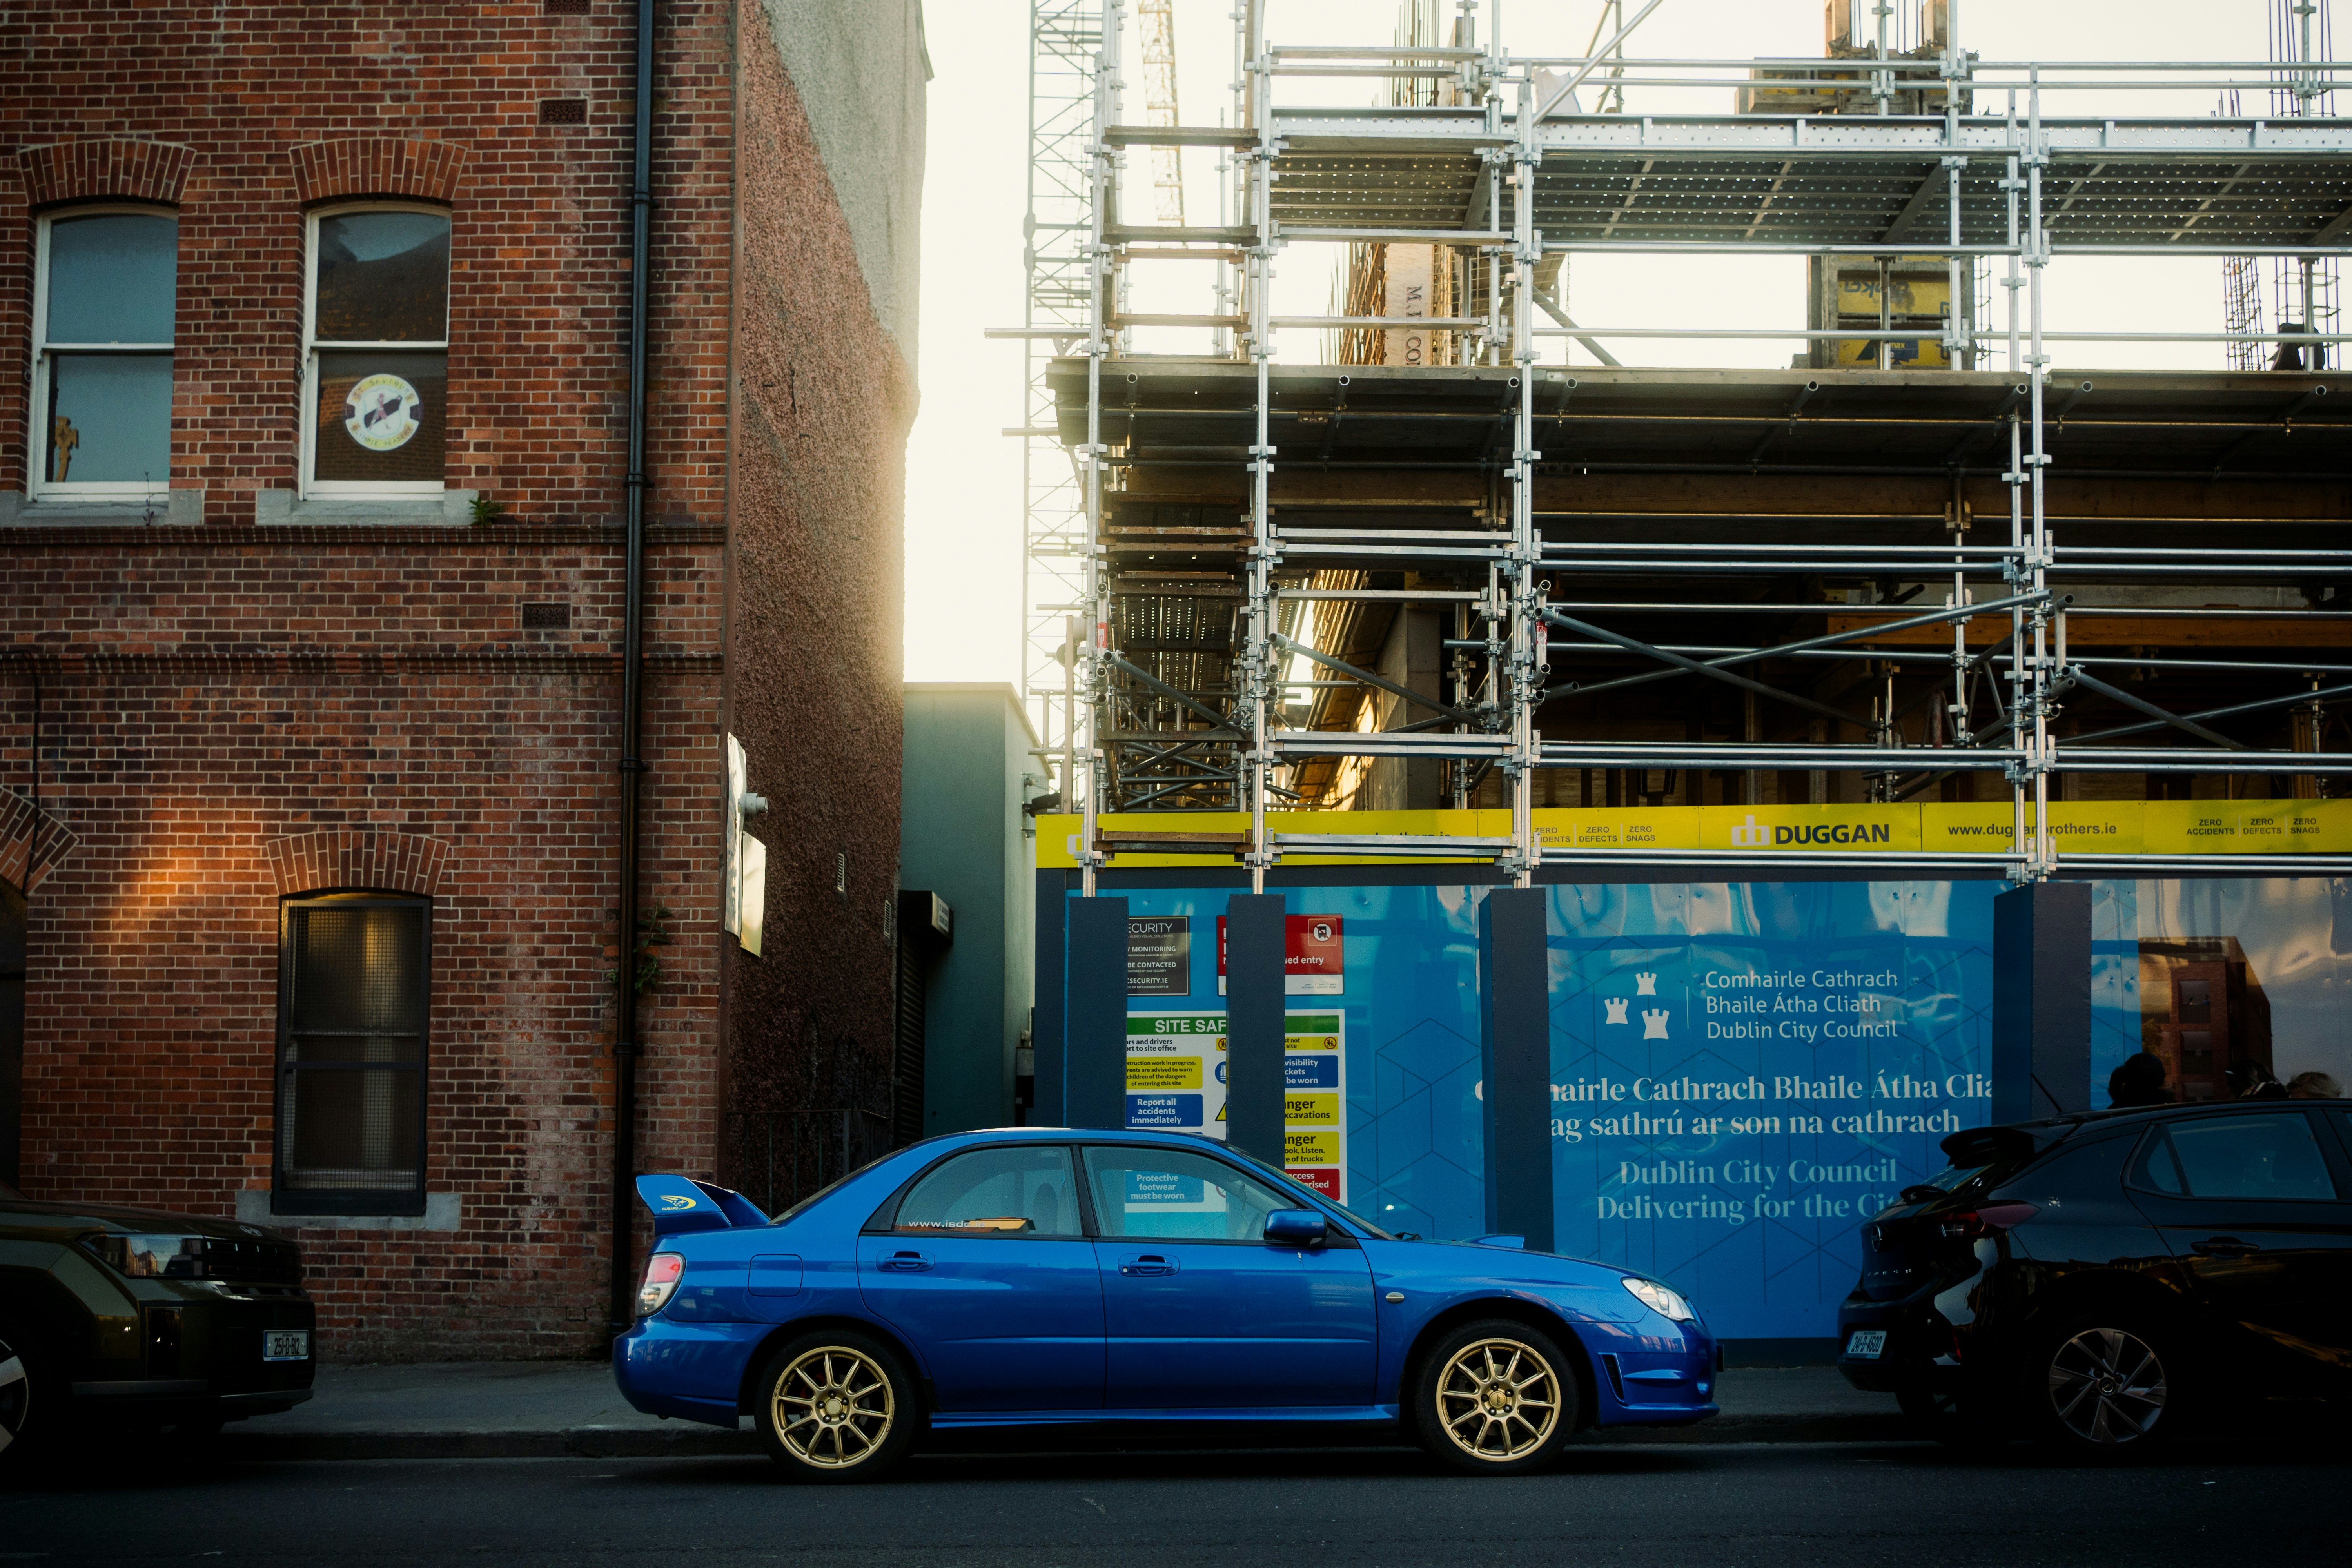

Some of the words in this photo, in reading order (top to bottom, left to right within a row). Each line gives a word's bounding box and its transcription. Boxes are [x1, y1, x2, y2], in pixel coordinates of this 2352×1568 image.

[1775, 824, 1889, 844] DUGGAN
[1948, 822, 2117, 838] www.dugarothers.ie
[1301, 956, 1324, 965] entry
[1705, 971, 1806, 989] Comhairle
[1812, 969, 1898, 987] Cathrach
[1707, 996, 1767, 1013] Bhaile
[1773, 992, 1817, 1013] Átha
[1824, 995, 1881, 1012] Cliath
[1155, 1020, 1190, 1033] SITE
[1195, 1019, 1226, 1032] SAF
[1708, 1021, 1772, 1039] Dublin
[1779, 1021, 1817, 1043] City
[1824, 1020, 1898, 1038] Council
[1633, 1076, 1766, 1102] Cathrach
[1774, 1075, 1862, 1100] Bhaile
[1871, 1069, 1938, 1099] Átha
[1946, 1073, 1992, 1098] Clia
[1137, 1098, 1165, 1107] Report
[1285, 1101, 1315, 1111] nger
[1132, 1116, 1181, 1124] immediately
[1551, 1117, 1582, 1143] ag
[1590, 1109, 1683, 1136] sathrú
[1692, 1116, 1723, 1134] ar
[1731, 1116, 1780, 1134] son
[1789, 1116, 1824, 1134] na
[1831, 1109, 1960, 1134] cathrach
[1285, 1136, 1316, 1146] nger
[1136, 1174, 1178, 1182] Protective
[1620, 1160, 1715, 1184] Dublin
[1723, 1160, 1780, 1190] City
[1789, 1158, 1897, 1183] Council
[1597, 1194, 1745, 1225] Delivering
[1753, 1194, 1795, 1218] for
[1803, 1194, 1849, 1218] the
[1857, 1193, 1895, 1217] Cit
[908, 1220, 985, 1228] www.isdc.ie
